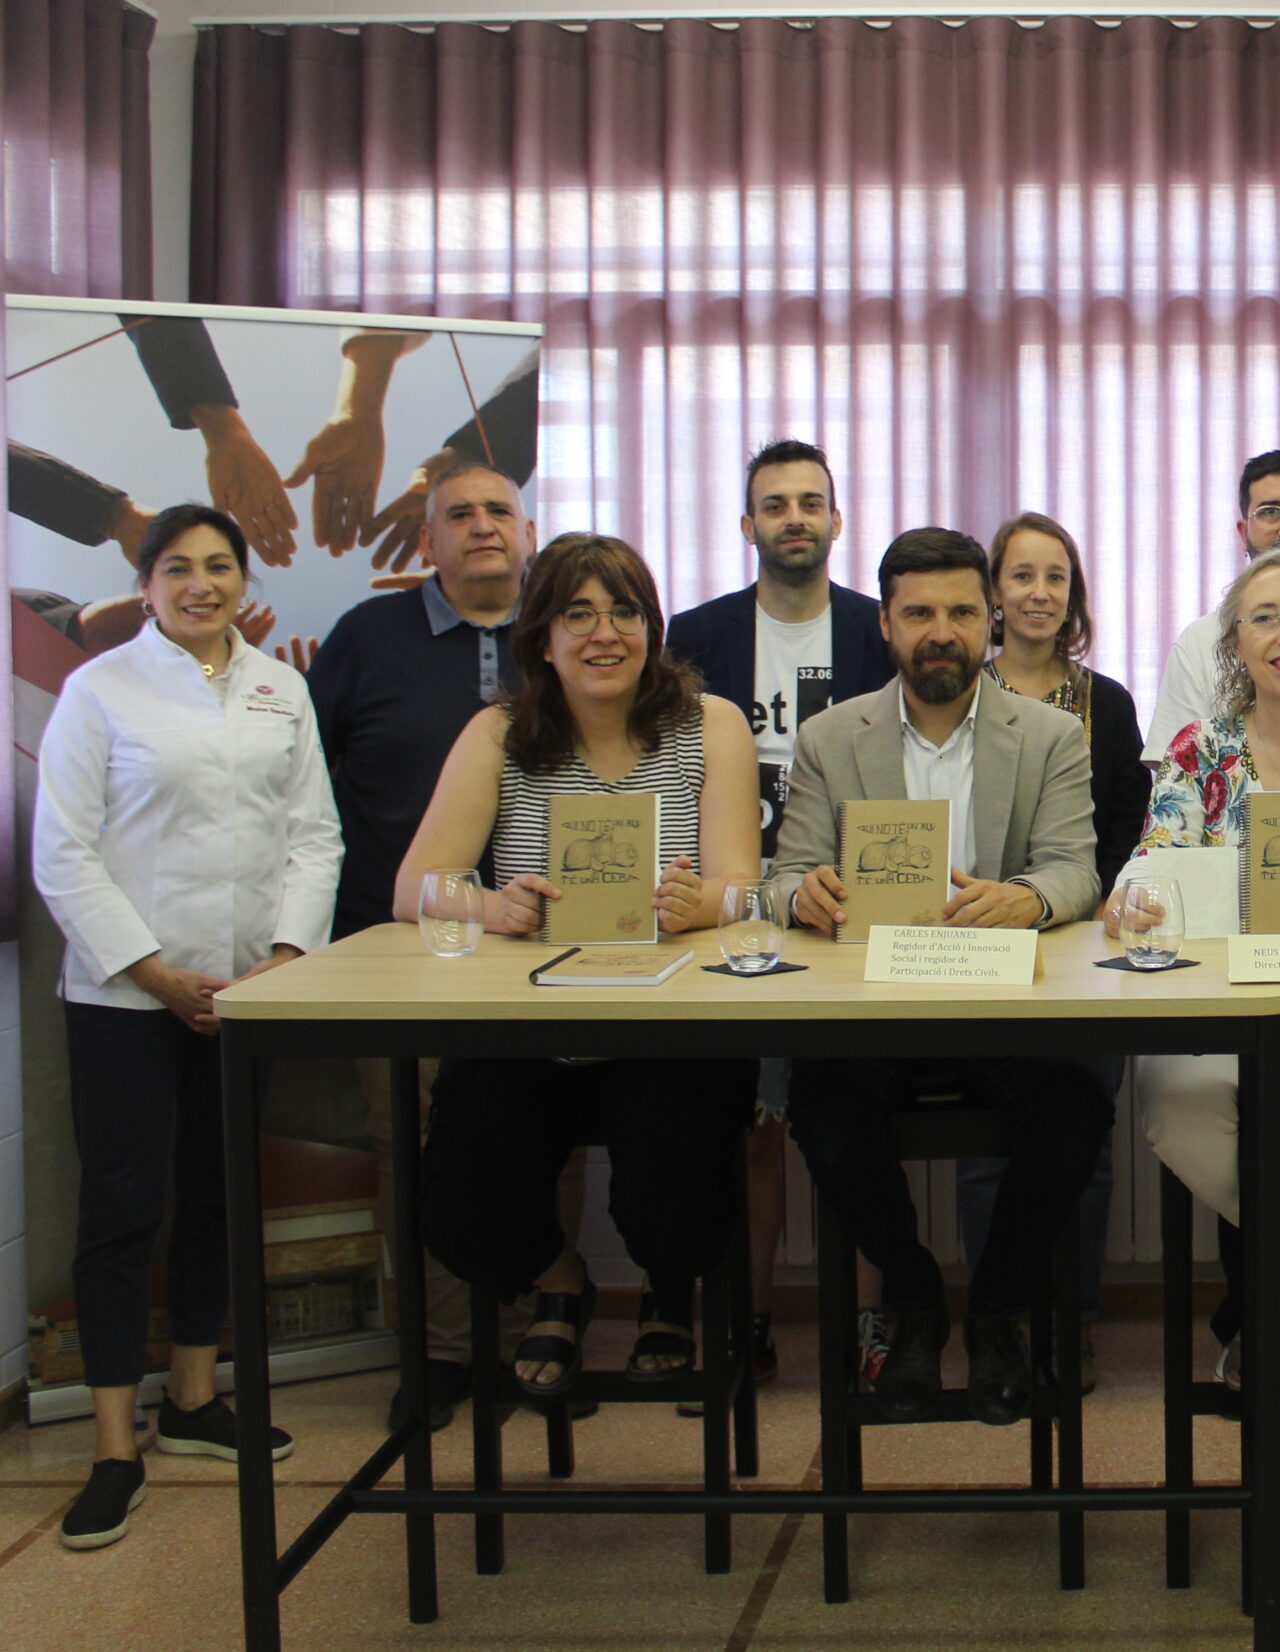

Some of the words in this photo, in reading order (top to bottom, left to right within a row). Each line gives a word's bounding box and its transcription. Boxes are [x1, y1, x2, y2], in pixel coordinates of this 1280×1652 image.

[897, 872, 934, 884] CEBA
[894, 929, 929, 938] CARLES
[930, 930, 978, 940] ENJUANES
[892, 941, 926, 952] Regidor
[929, 943, 961, 951] d'Acció
[968, 944, 1011, 953] Innovació
[1254, 949, 1279, 957] NEUS
[891, 954, 917, 963] Social
[924, 955, 956, 965] regidor
[958, 956, 969, 964] de
[890, 967, 942, 977] Participació
[949, 968, 973, 976] Drets
[974, 969, 1001, 977] Civils.
